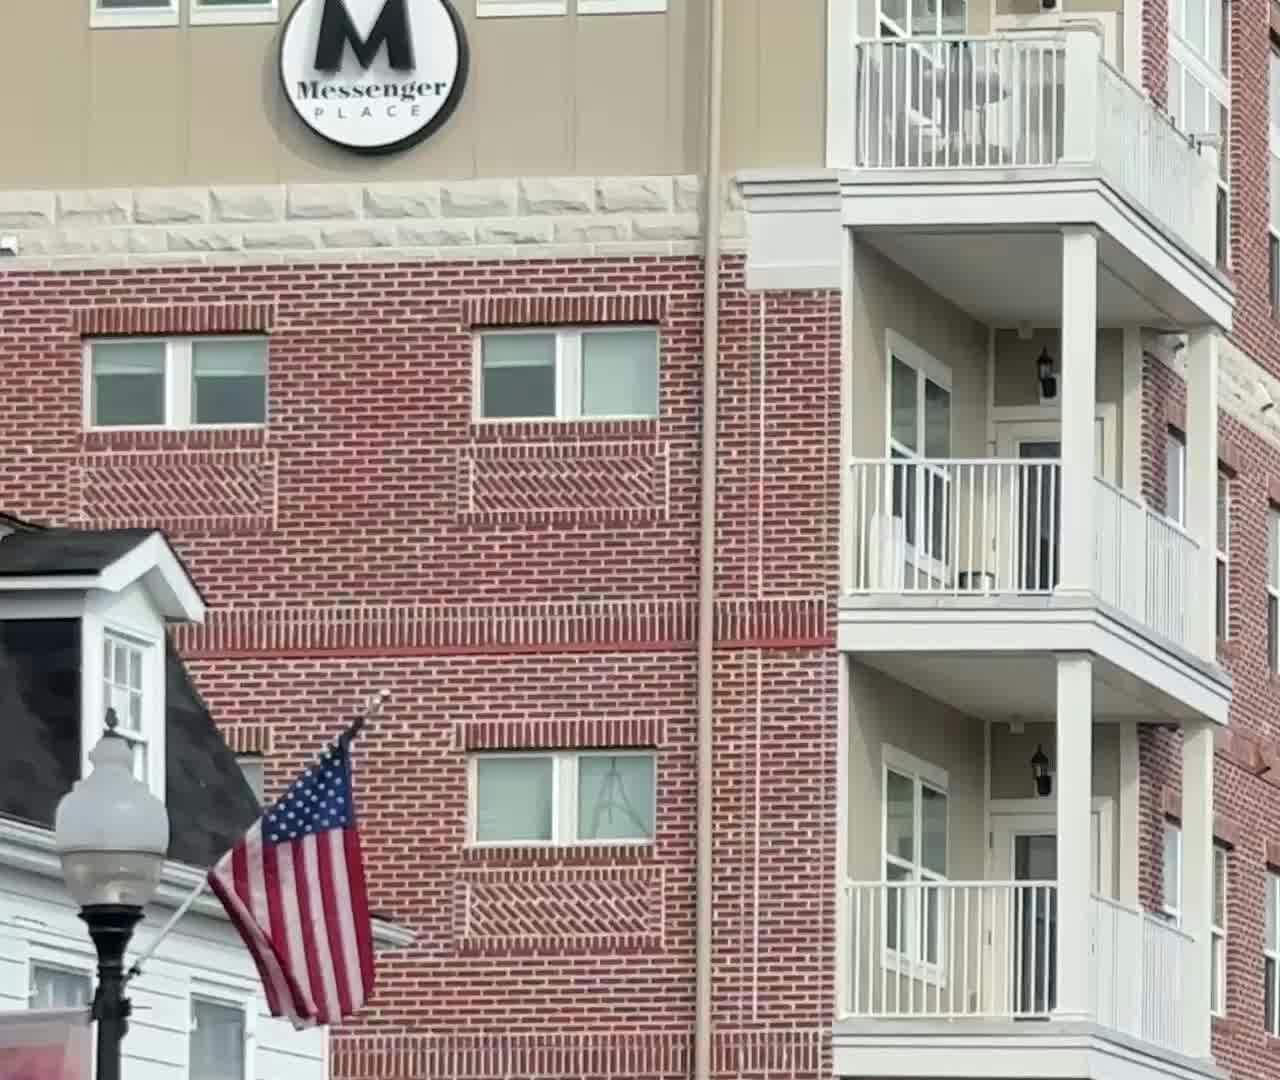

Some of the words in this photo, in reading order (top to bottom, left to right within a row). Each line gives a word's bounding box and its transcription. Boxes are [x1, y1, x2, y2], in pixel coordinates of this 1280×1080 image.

[314, 0, 416, 70] M
[296, 80, 447, 101] Messenger
[314, 104, 421, 119] PLACE
